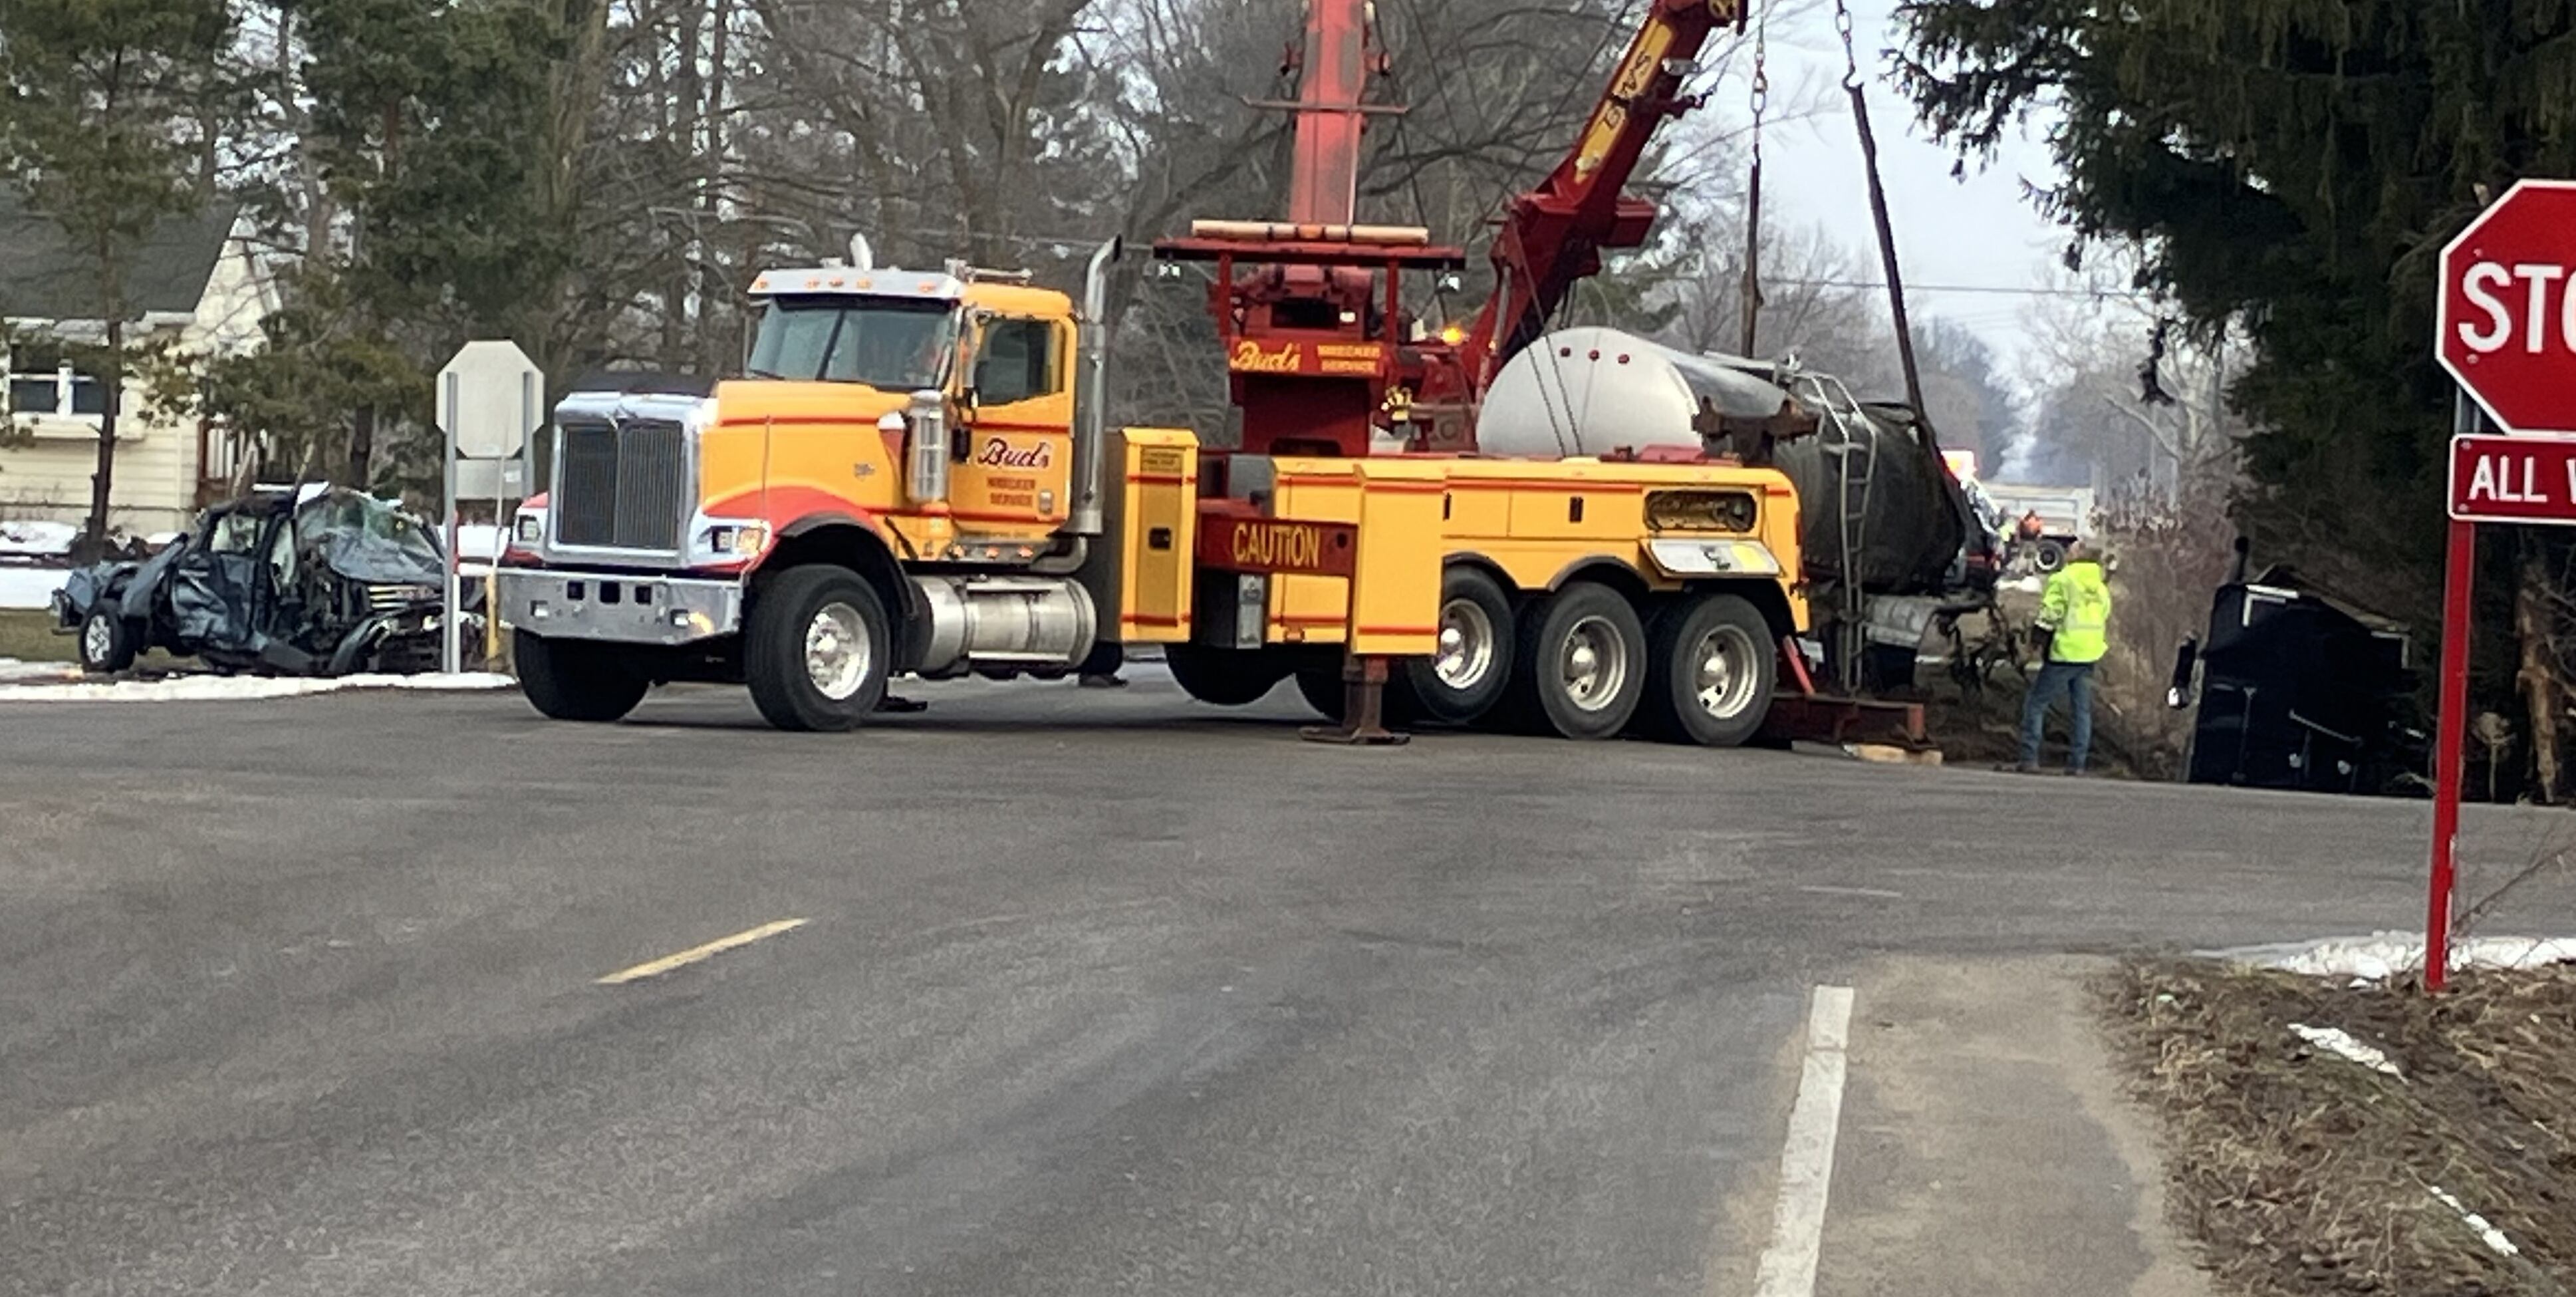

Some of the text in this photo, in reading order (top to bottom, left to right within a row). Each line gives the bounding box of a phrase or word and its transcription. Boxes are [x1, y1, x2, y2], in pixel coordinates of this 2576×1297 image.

[2458, 261, 2576, 354] ST
[2468, 455, 2548, 503] ALL
[1233, 522, 1321, 568] CAUTION
